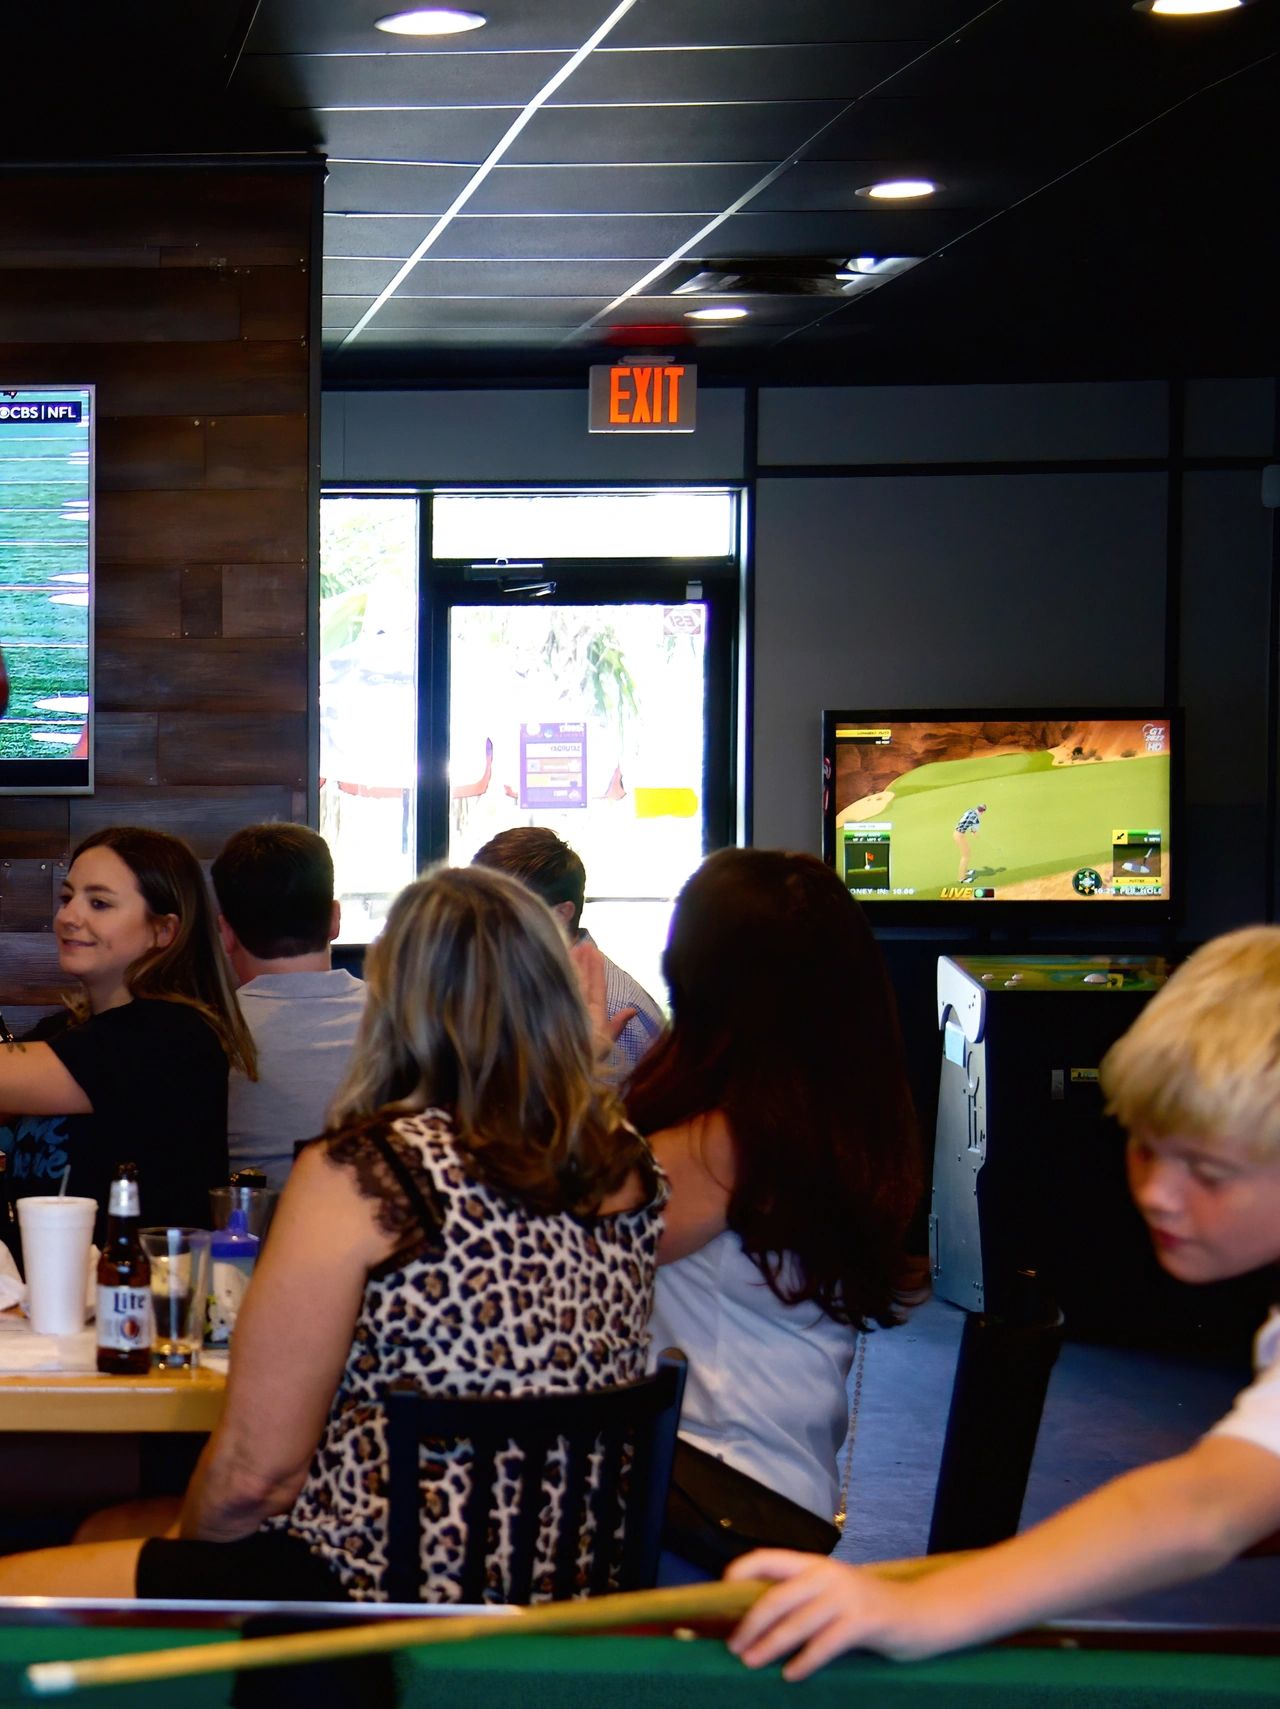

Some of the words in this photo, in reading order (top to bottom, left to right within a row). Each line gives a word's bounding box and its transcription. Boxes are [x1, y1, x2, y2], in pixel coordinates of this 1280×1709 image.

[609, 366, 685, 423] EXIT
[47, 406, 76, 418] NFL
[940, 887, 972, 898] LIVE
[113, 1291, 146, 1314] Lite
